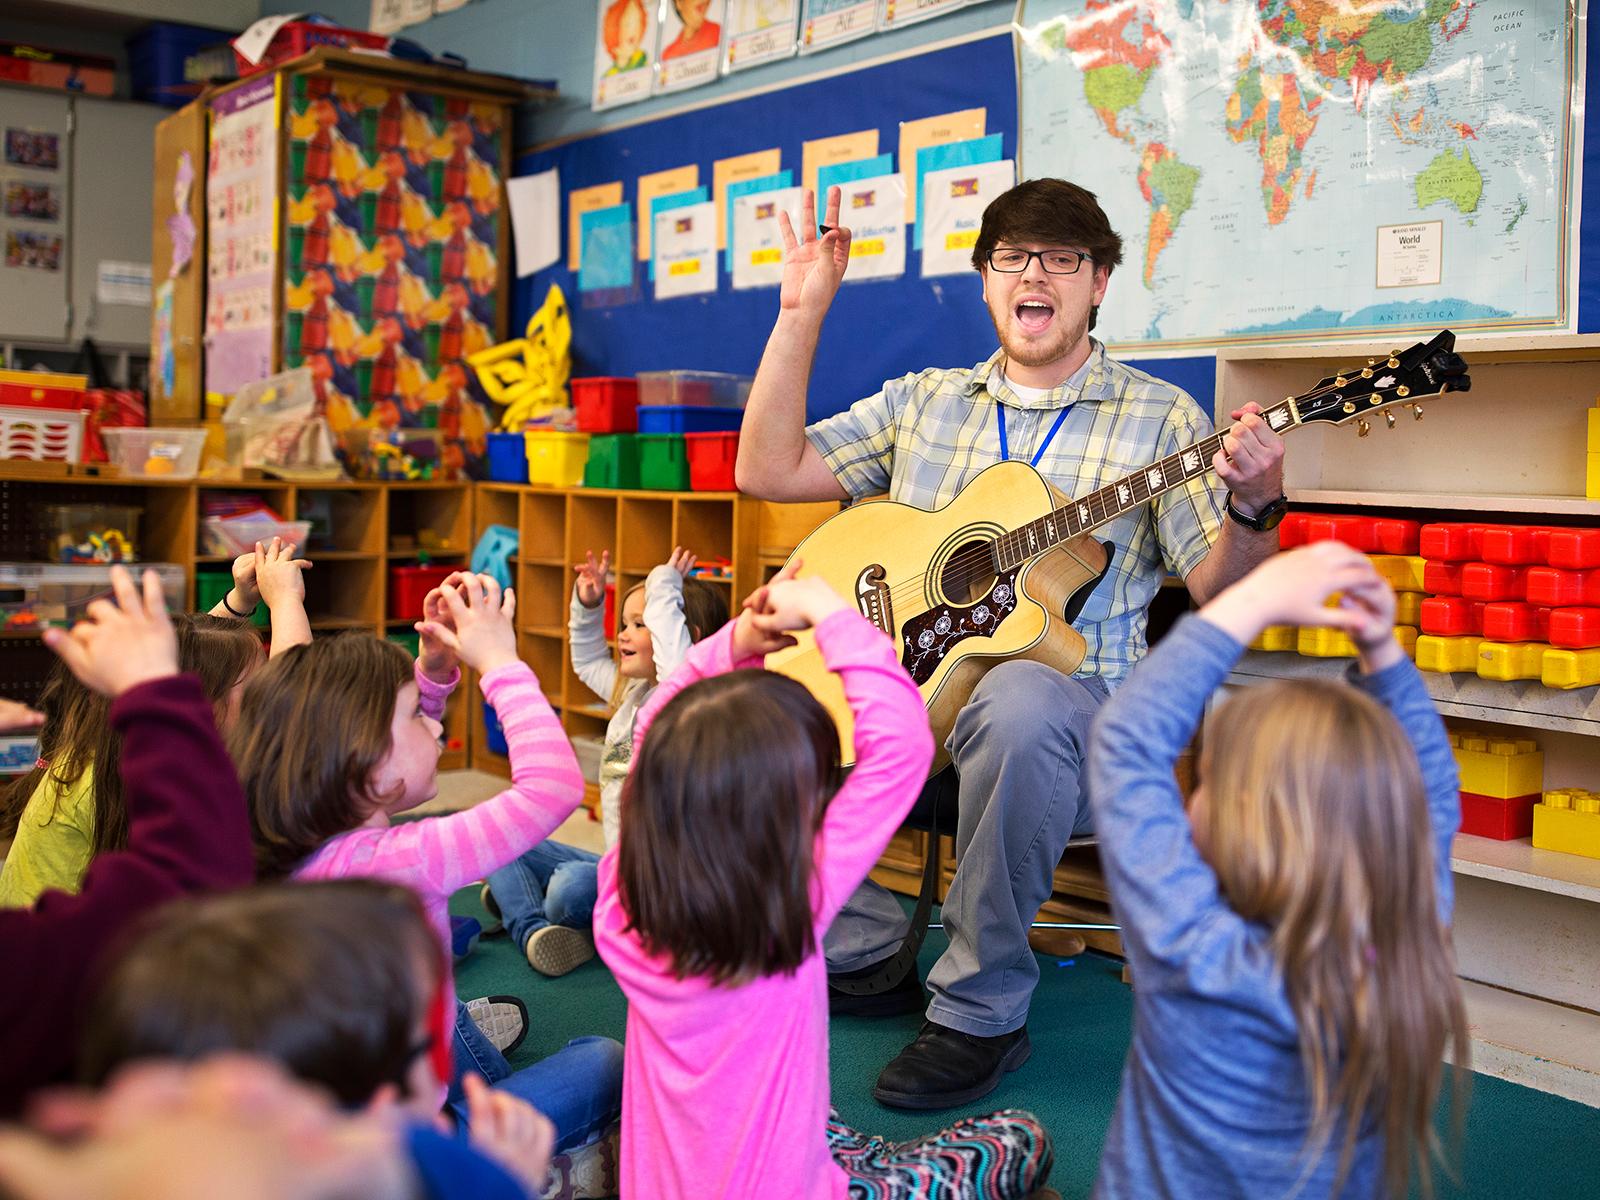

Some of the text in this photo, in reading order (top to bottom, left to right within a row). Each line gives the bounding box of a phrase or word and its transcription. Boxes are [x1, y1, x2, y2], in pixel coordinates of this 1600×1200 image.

[1492, 9, 1525, 21] PACIFIC
[1494, 22, 1522, 32] OCEAN
[1399, 234, 1421, 244] World
[1379, 311, 1455, 322] ANTARCTICA
